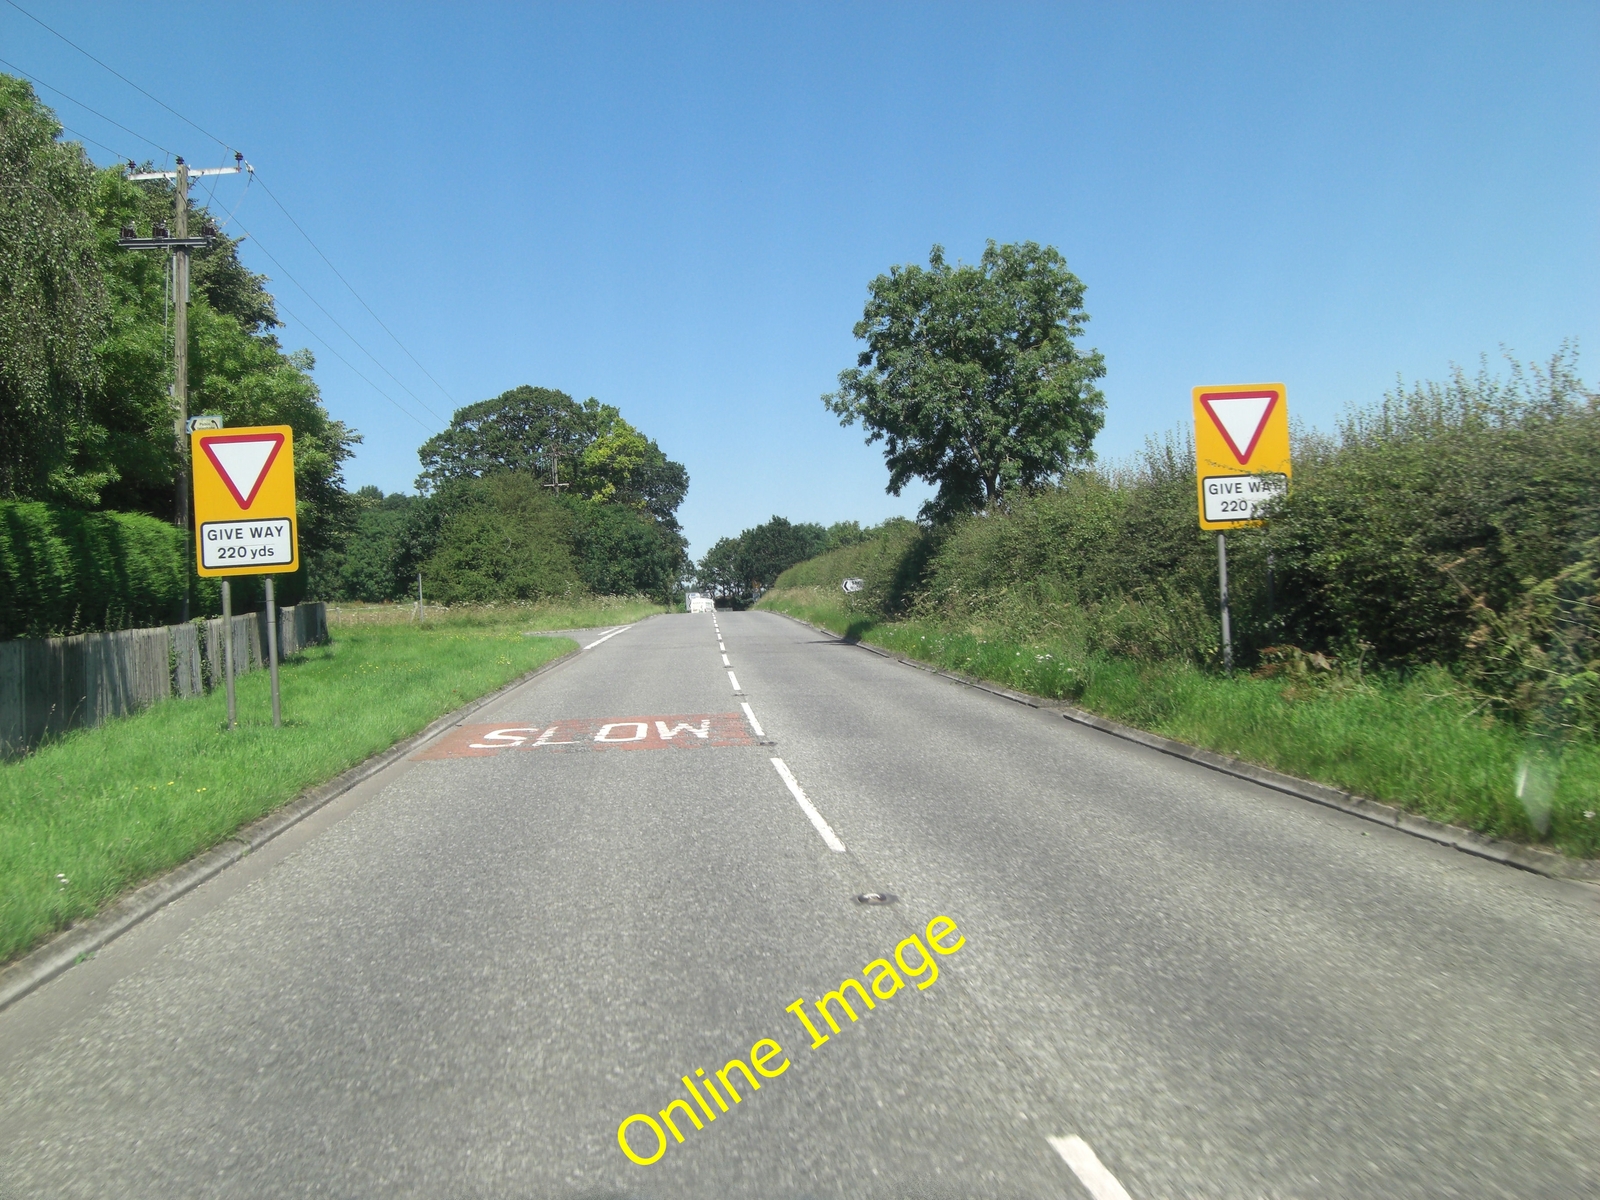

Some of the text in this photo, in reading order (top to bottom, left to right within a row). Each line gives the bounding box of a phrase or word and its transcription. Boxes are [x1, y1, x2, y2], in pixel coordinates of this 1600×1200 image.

[1208, 482, 1243, 495] GIVE
[1220, 500, 1248, 512] 220
[207, 526, 284, 541] GIVE WAY
[217, 545, 275, 560] 220 yds
[468, 719, 710, 749] SLOW
